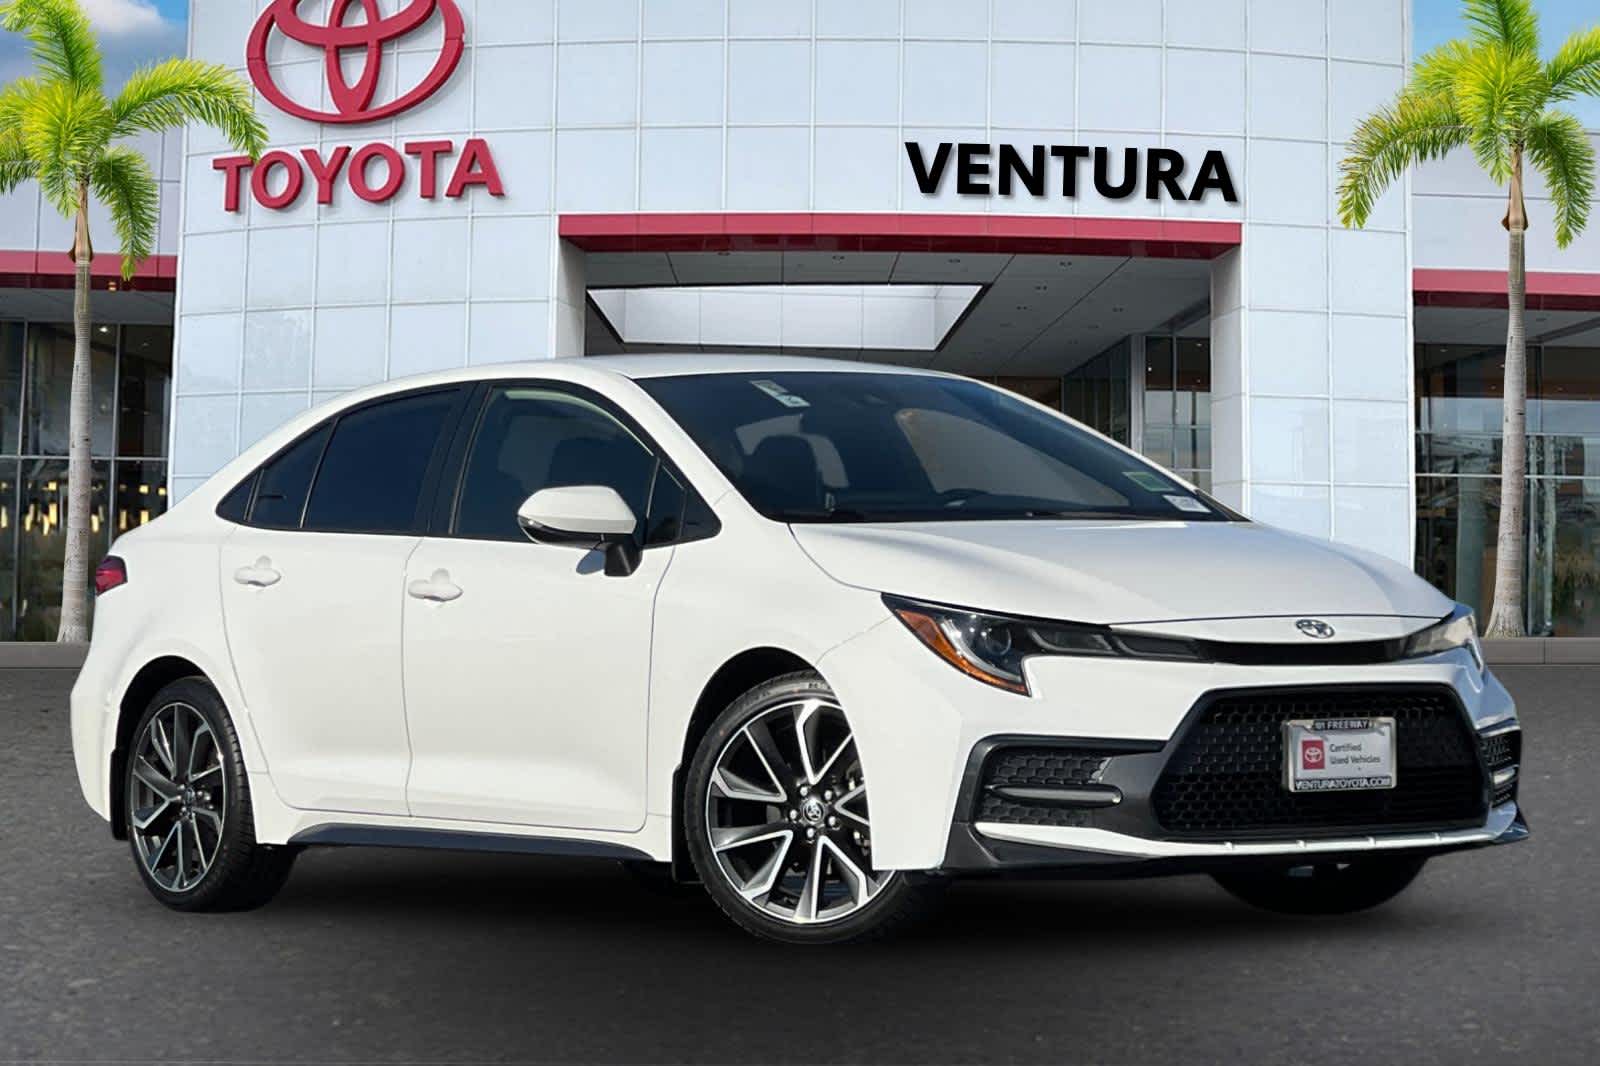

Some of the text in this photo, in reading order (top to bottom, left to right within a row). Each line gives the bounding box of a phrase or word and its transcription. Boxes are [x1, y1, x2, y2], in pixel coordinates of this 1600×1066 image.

[213, 138, 505, 212] TOYOTA
[904, 142, 1238, 203] VENTURA
[1327, 720, 1367, 729] FREEWAY
[1329, 743, 1362, 752] Certified
[1330, 755, 1381, 765] Used Vehicles
